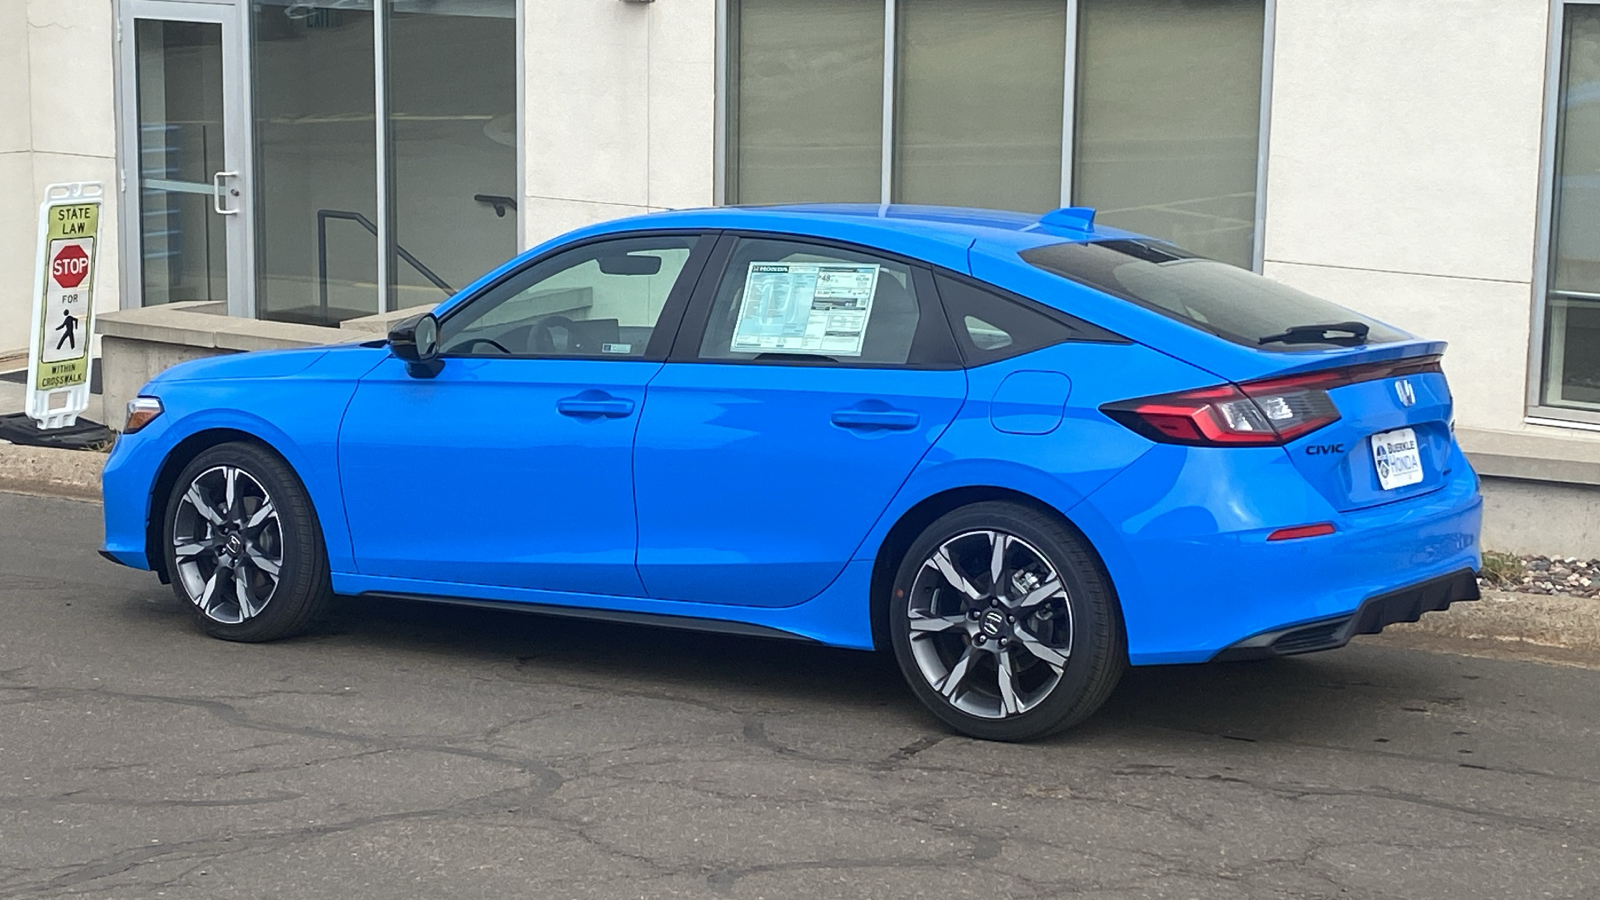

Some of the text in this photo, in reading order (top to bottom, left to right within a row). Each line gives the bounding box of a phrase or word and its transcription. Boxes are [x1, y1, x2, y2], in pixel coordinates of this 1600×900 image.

[58, 208, 91, 221] STATE
[62, 222, 86, 235] LAW
[53, 257, 89, 276] STOP
[62, 293, 79, 304] FOR
[51, 363, 76, 375] WITHIN
[42, 373, 82, 388] CROSSWALK
[1305, 443, 1345, 456] CIVIC
[1389, 454, 1419, 473] HONDA
